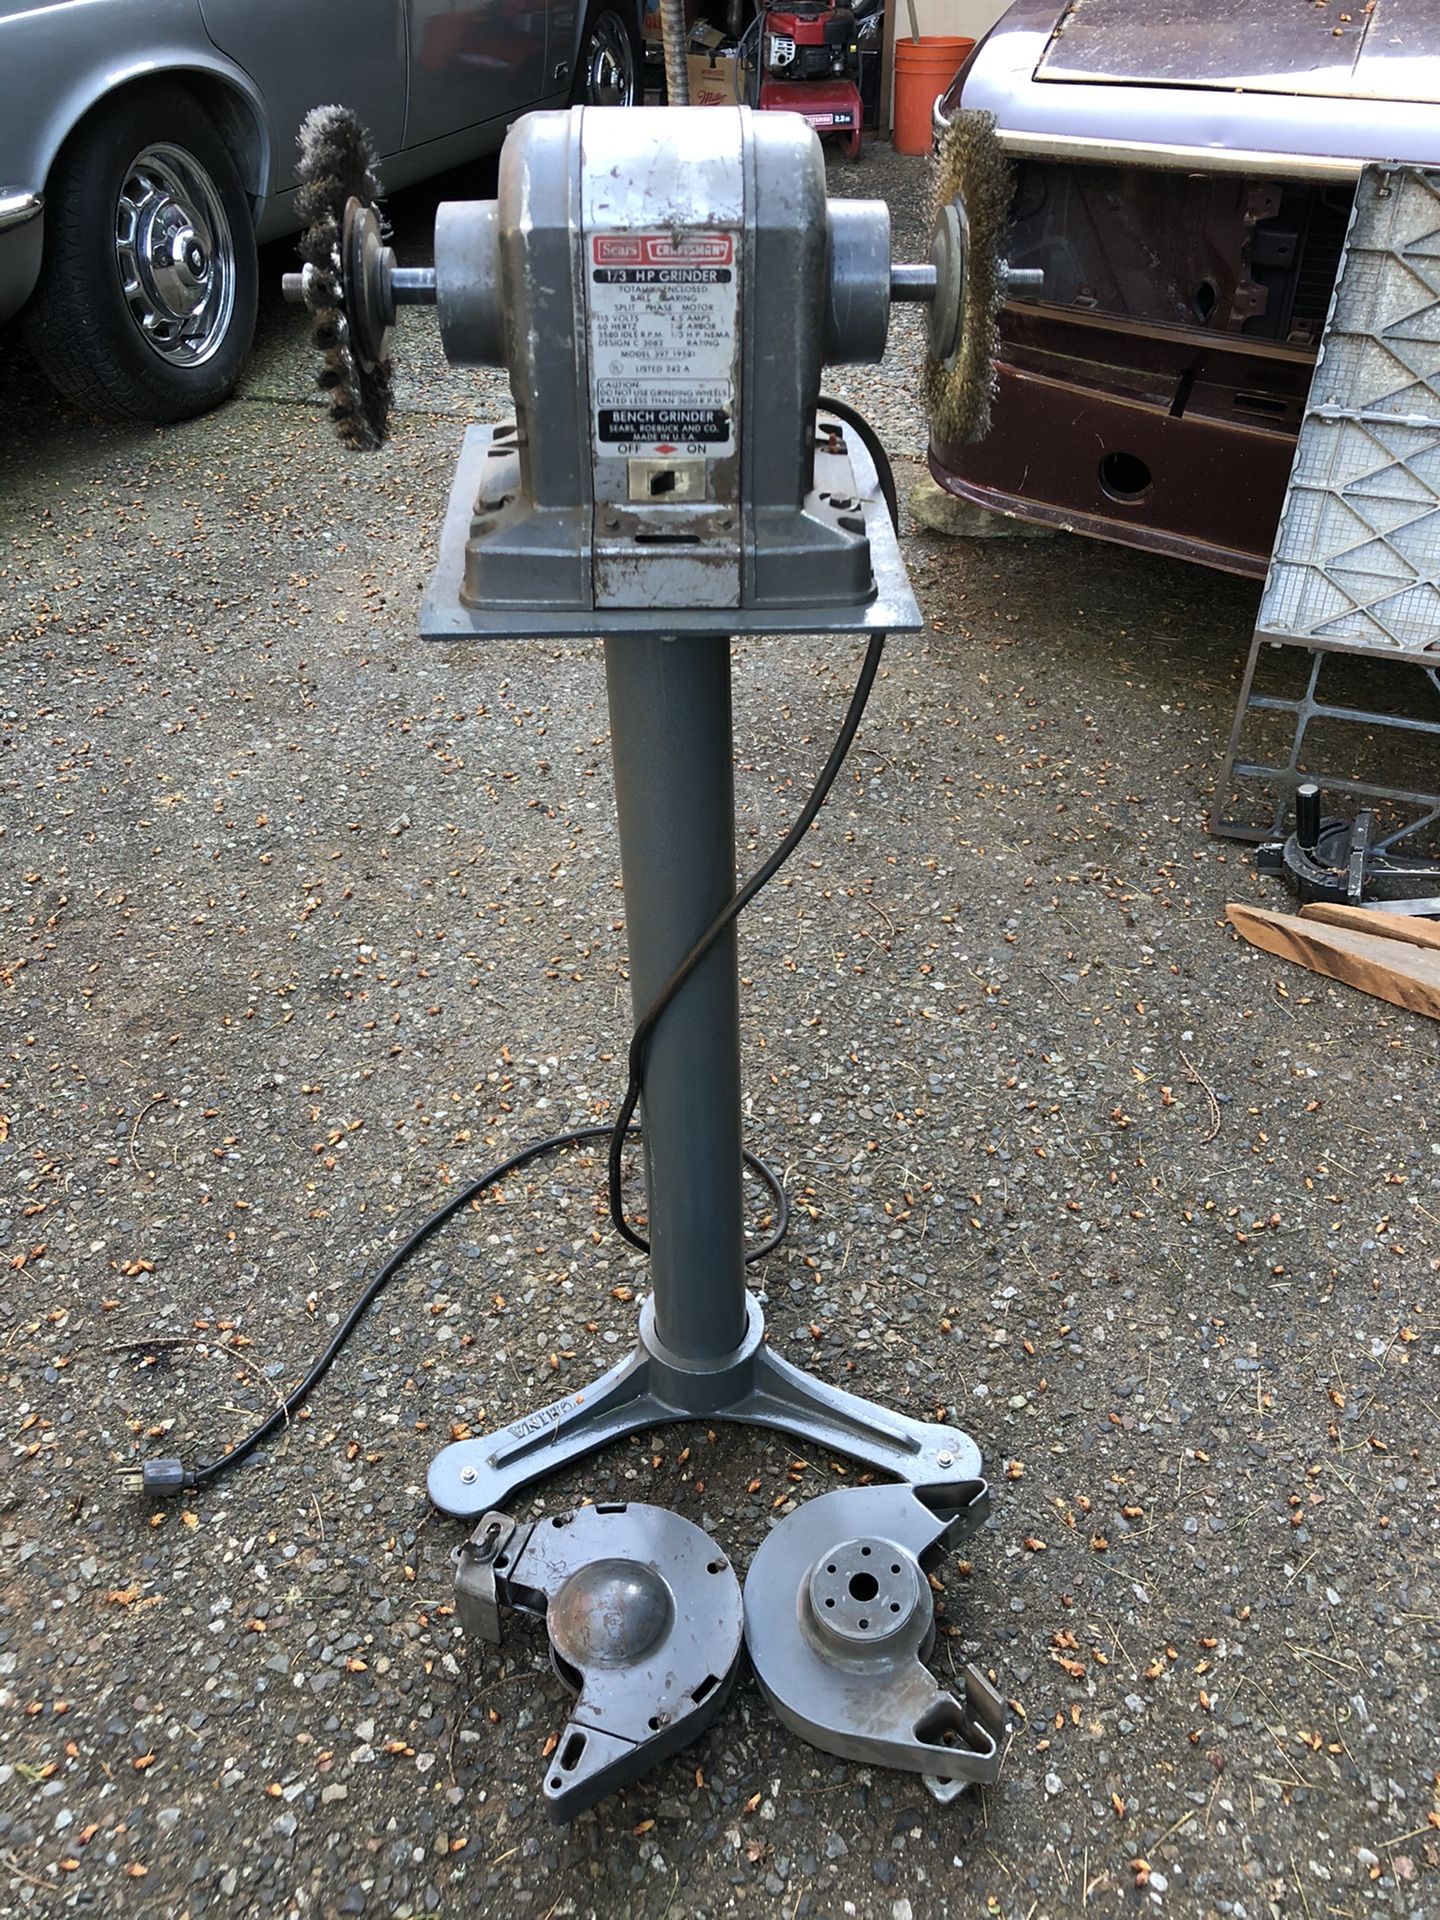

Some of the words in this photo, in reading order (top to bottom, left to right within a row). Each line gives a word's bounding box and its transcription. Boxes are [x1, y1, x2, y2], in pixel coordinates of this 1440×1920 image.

[602, 242, 638, 256] Sears
[656, 244, 723, 256] CRAFTSMAN
[607, 270, 626, 282] 1/3
[636, 270, 655, 281] HP
[659, 270, 717, 281] GRINDER
[662, 285, 708, 293] ENCLOSED
[631, 294, 650, 302] BALL
[682, 303, 714, 311] MOTOR
[687, 339, 720, 347] RATING
[635, 365, 663, 373] LISTED
[600, 389, 613, 397] DO
[613, 412, 654, 422] BENCH
[659, 411, 714, 422] GRINDER
[639, 424, 679, 433] ROEBUCK
[682, 424, 701, 432] AND
[704, 424, 719, 433] CO.
[633, 433, 658, 441] MADE
[617, 444, 641, 454] OFF
[687, 444, 707, 454] ON
[507, 1402, 576, 1439] CHINA
